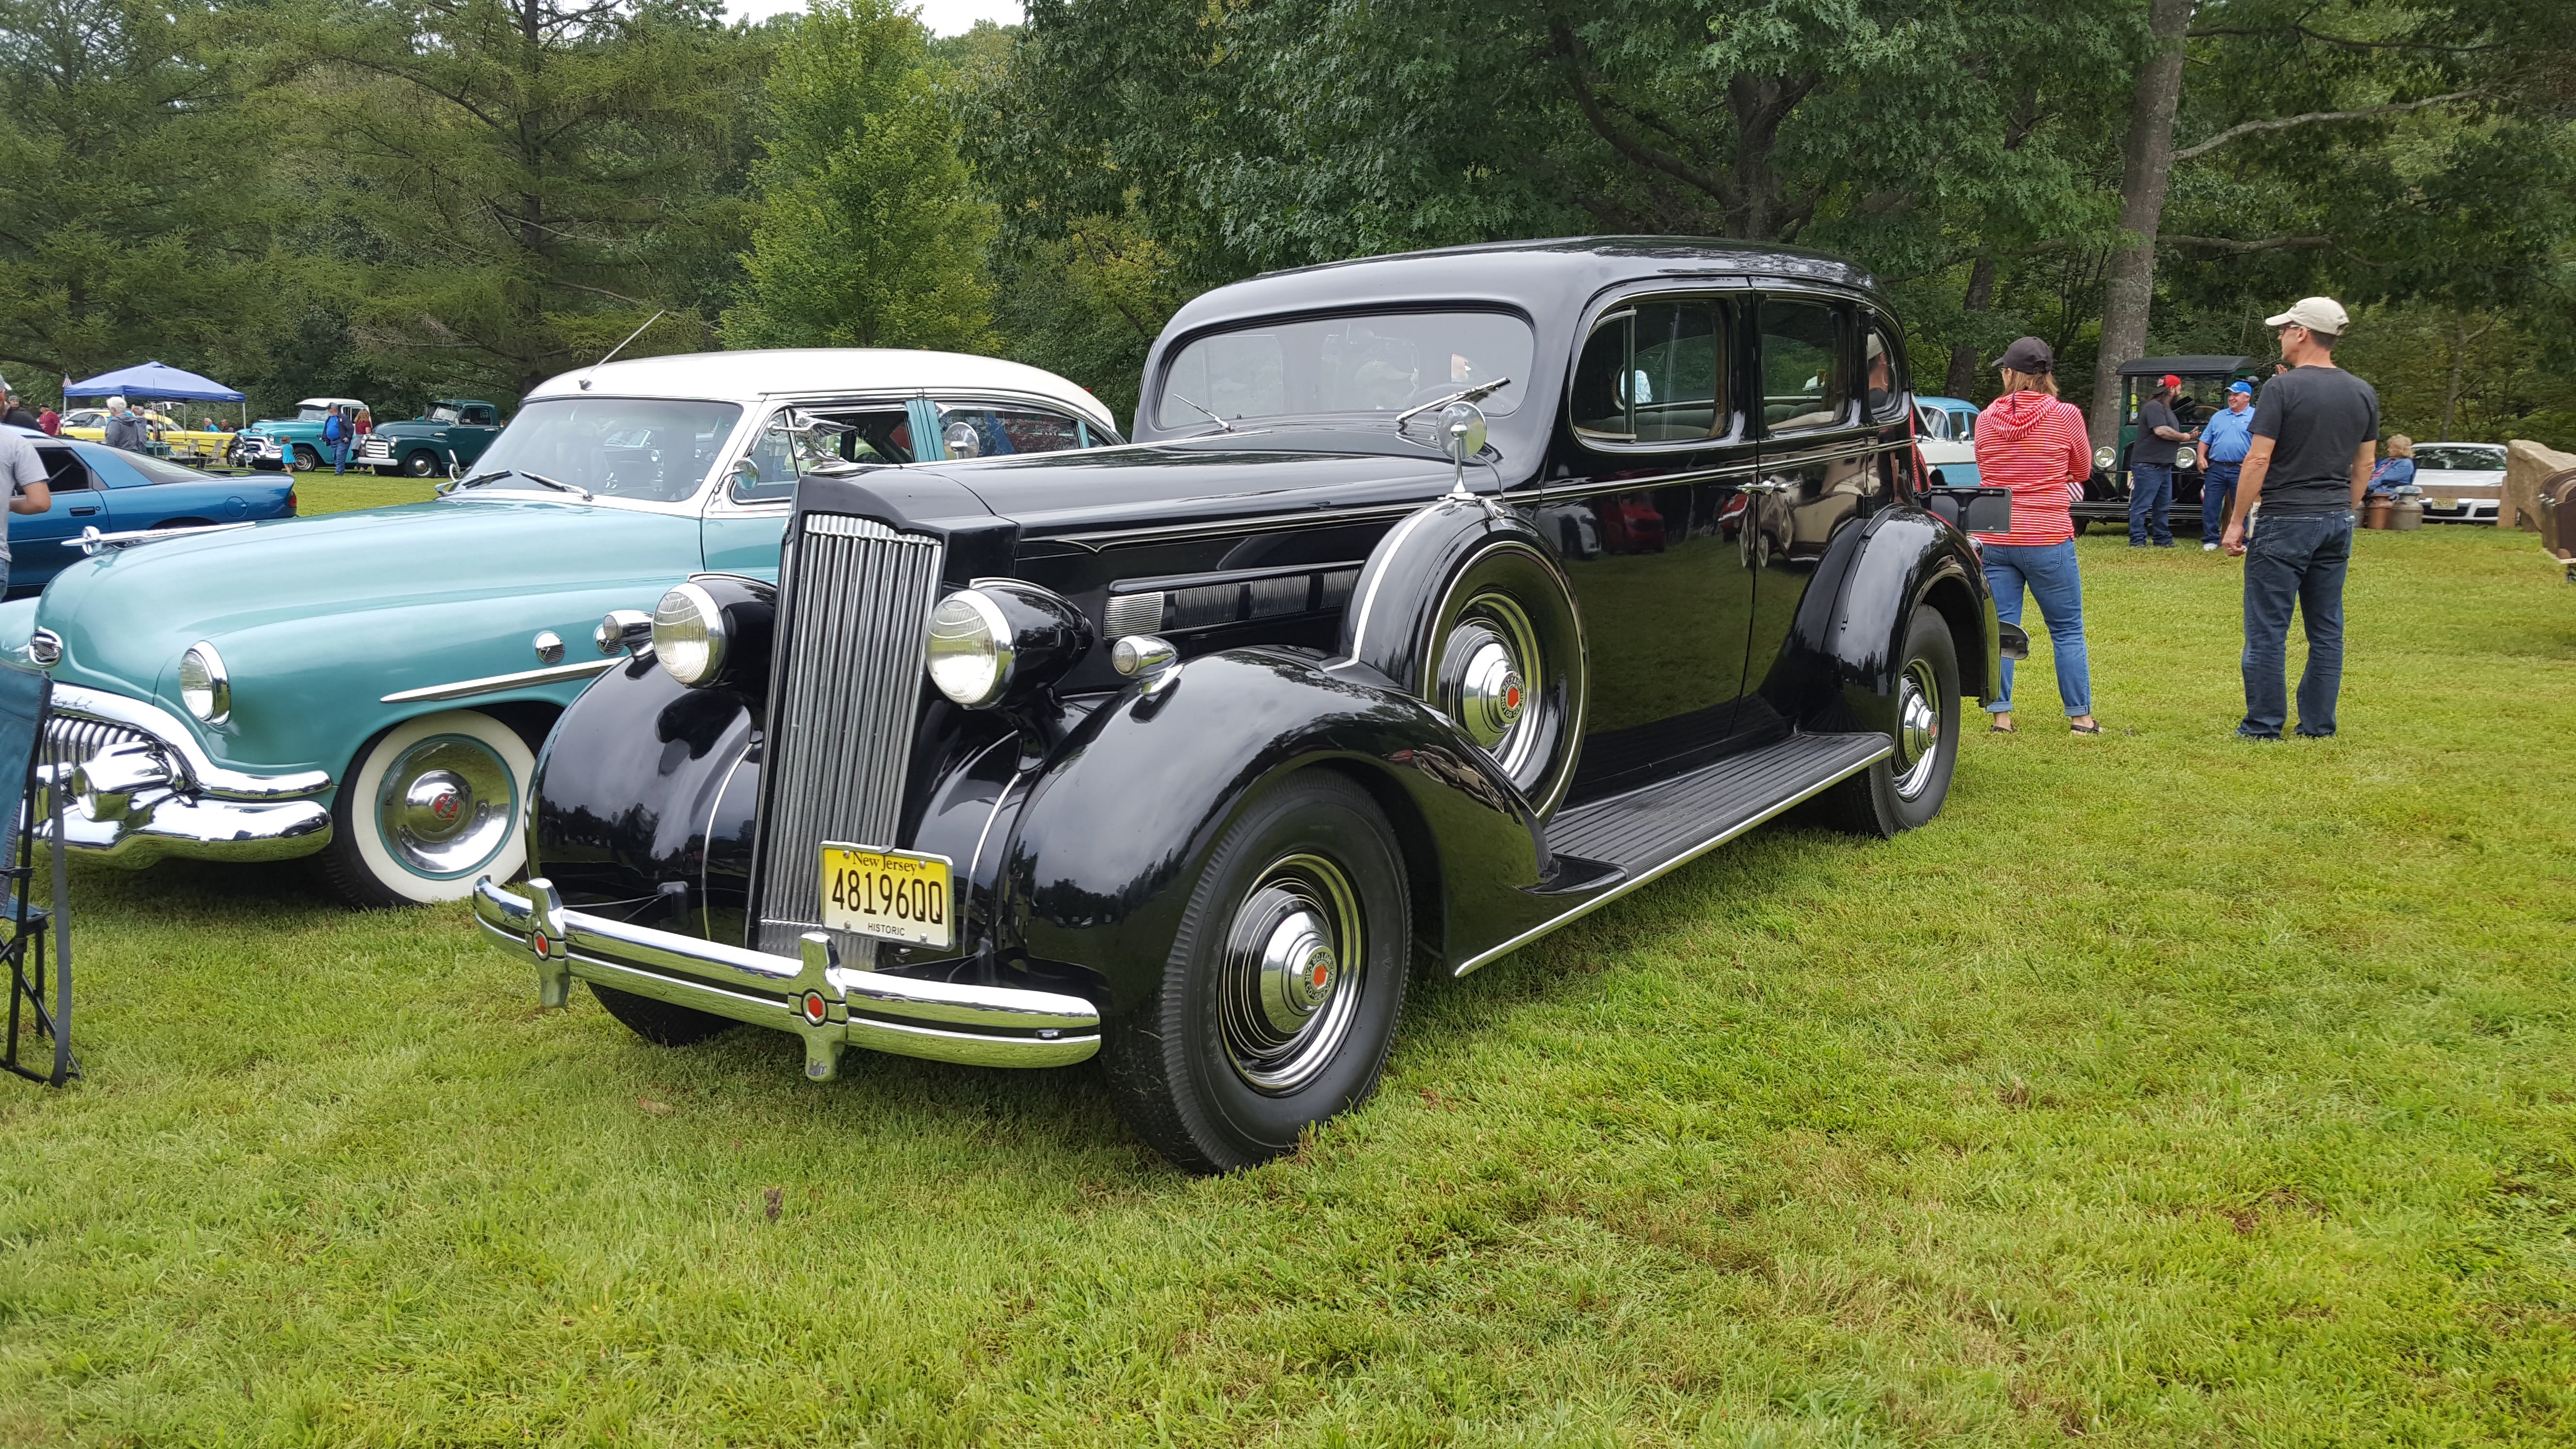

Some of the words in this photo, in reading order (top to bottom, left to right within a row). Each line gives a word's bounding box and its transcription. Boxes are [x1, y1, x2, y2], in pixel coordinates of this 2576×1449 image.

[1502, 677, 1522, 692] PACKARD
[1501, 696, 1513, 718] MOTOR
[1513, 705, 1521, 717] CAR
[853, 851, 880, 868] New
[881, 855, 917, 876] Jersey
[832, 868, 943, 925] 48196QQ
[868, 922, 905, 936] HISTORIC
[1312, 952, 1332, 965] MOTOR
